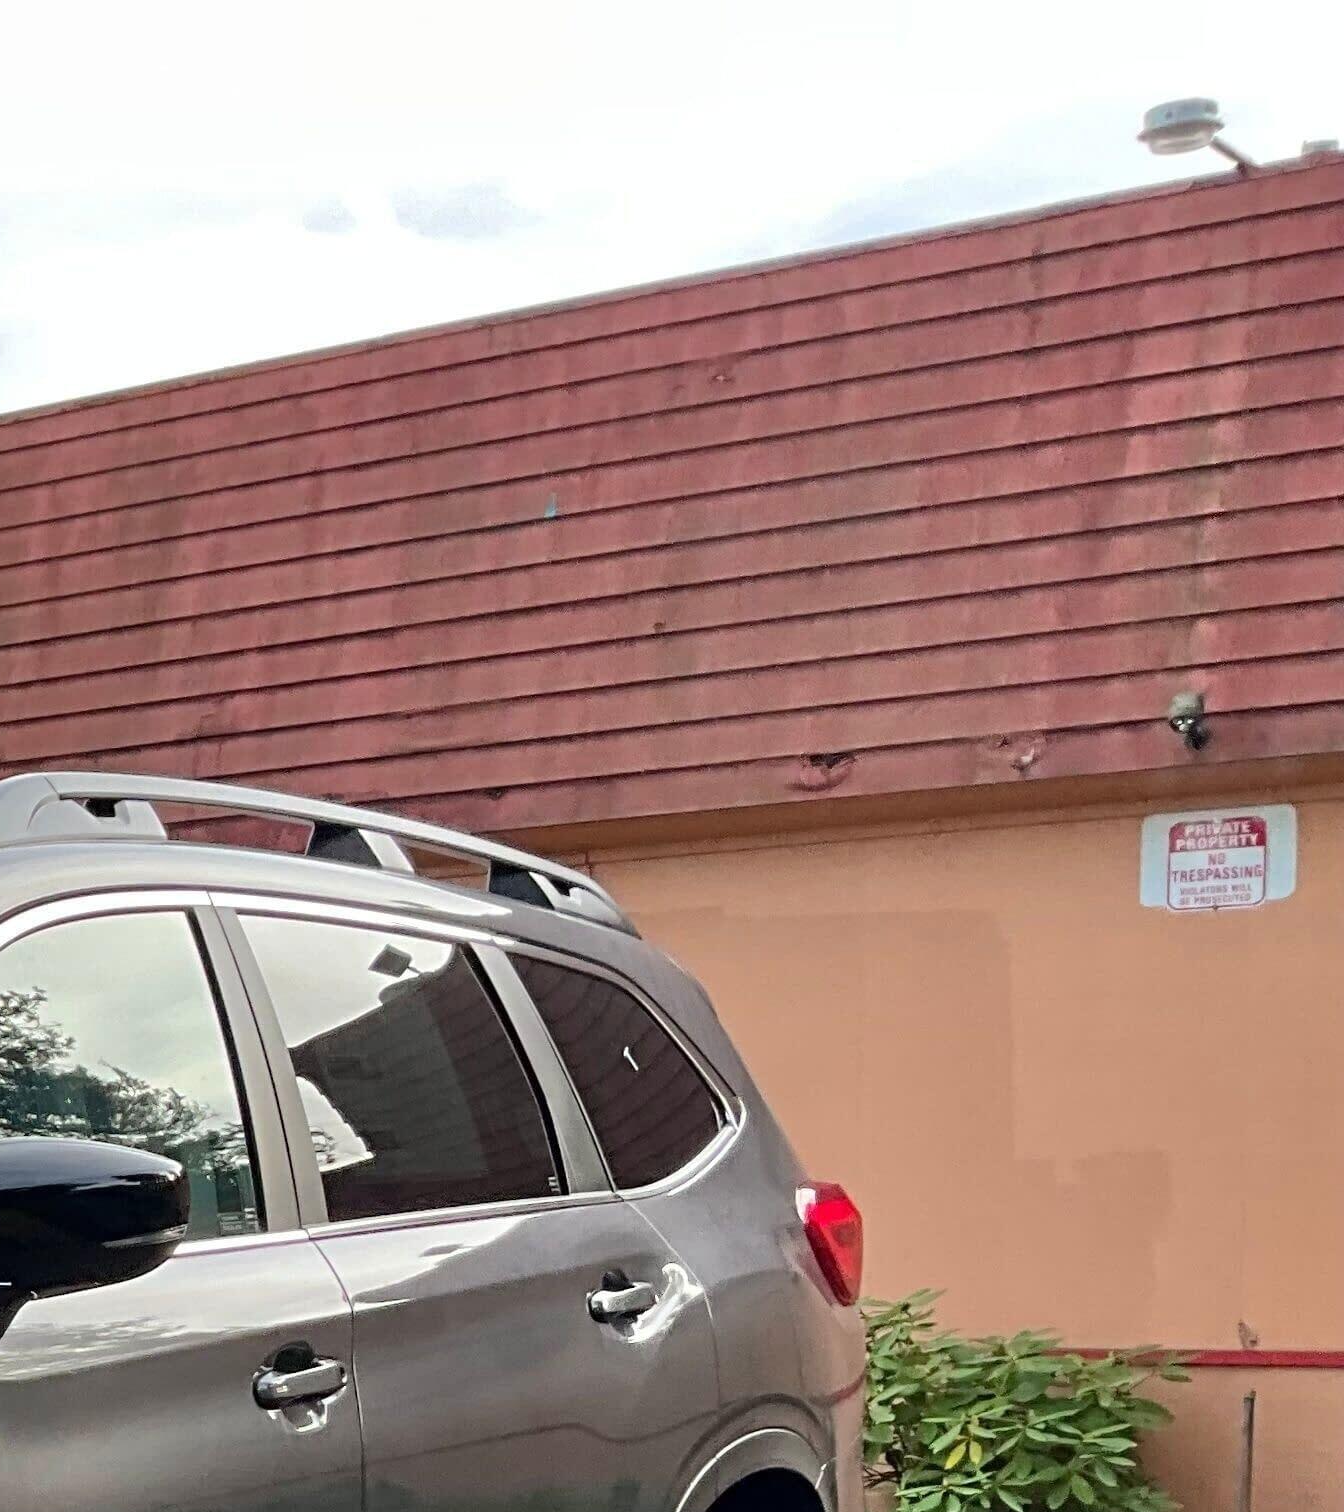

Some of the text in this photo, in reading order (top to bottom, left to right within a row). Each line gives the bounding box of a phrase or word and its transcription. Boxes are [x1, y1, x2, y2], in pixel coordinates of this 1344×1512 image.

[1184, 821, 1252, 836] PRIVATE
[1176, 834, 1258, 850] PROPERTY
[1207, 852, 1226, 866] NO
[1172, 865, 1263, 883] TRESPASSING
[1180, 882, 1252, 896] VIOLATORS WILL
[1194, 893, 1252, 905] PROSECUTED
